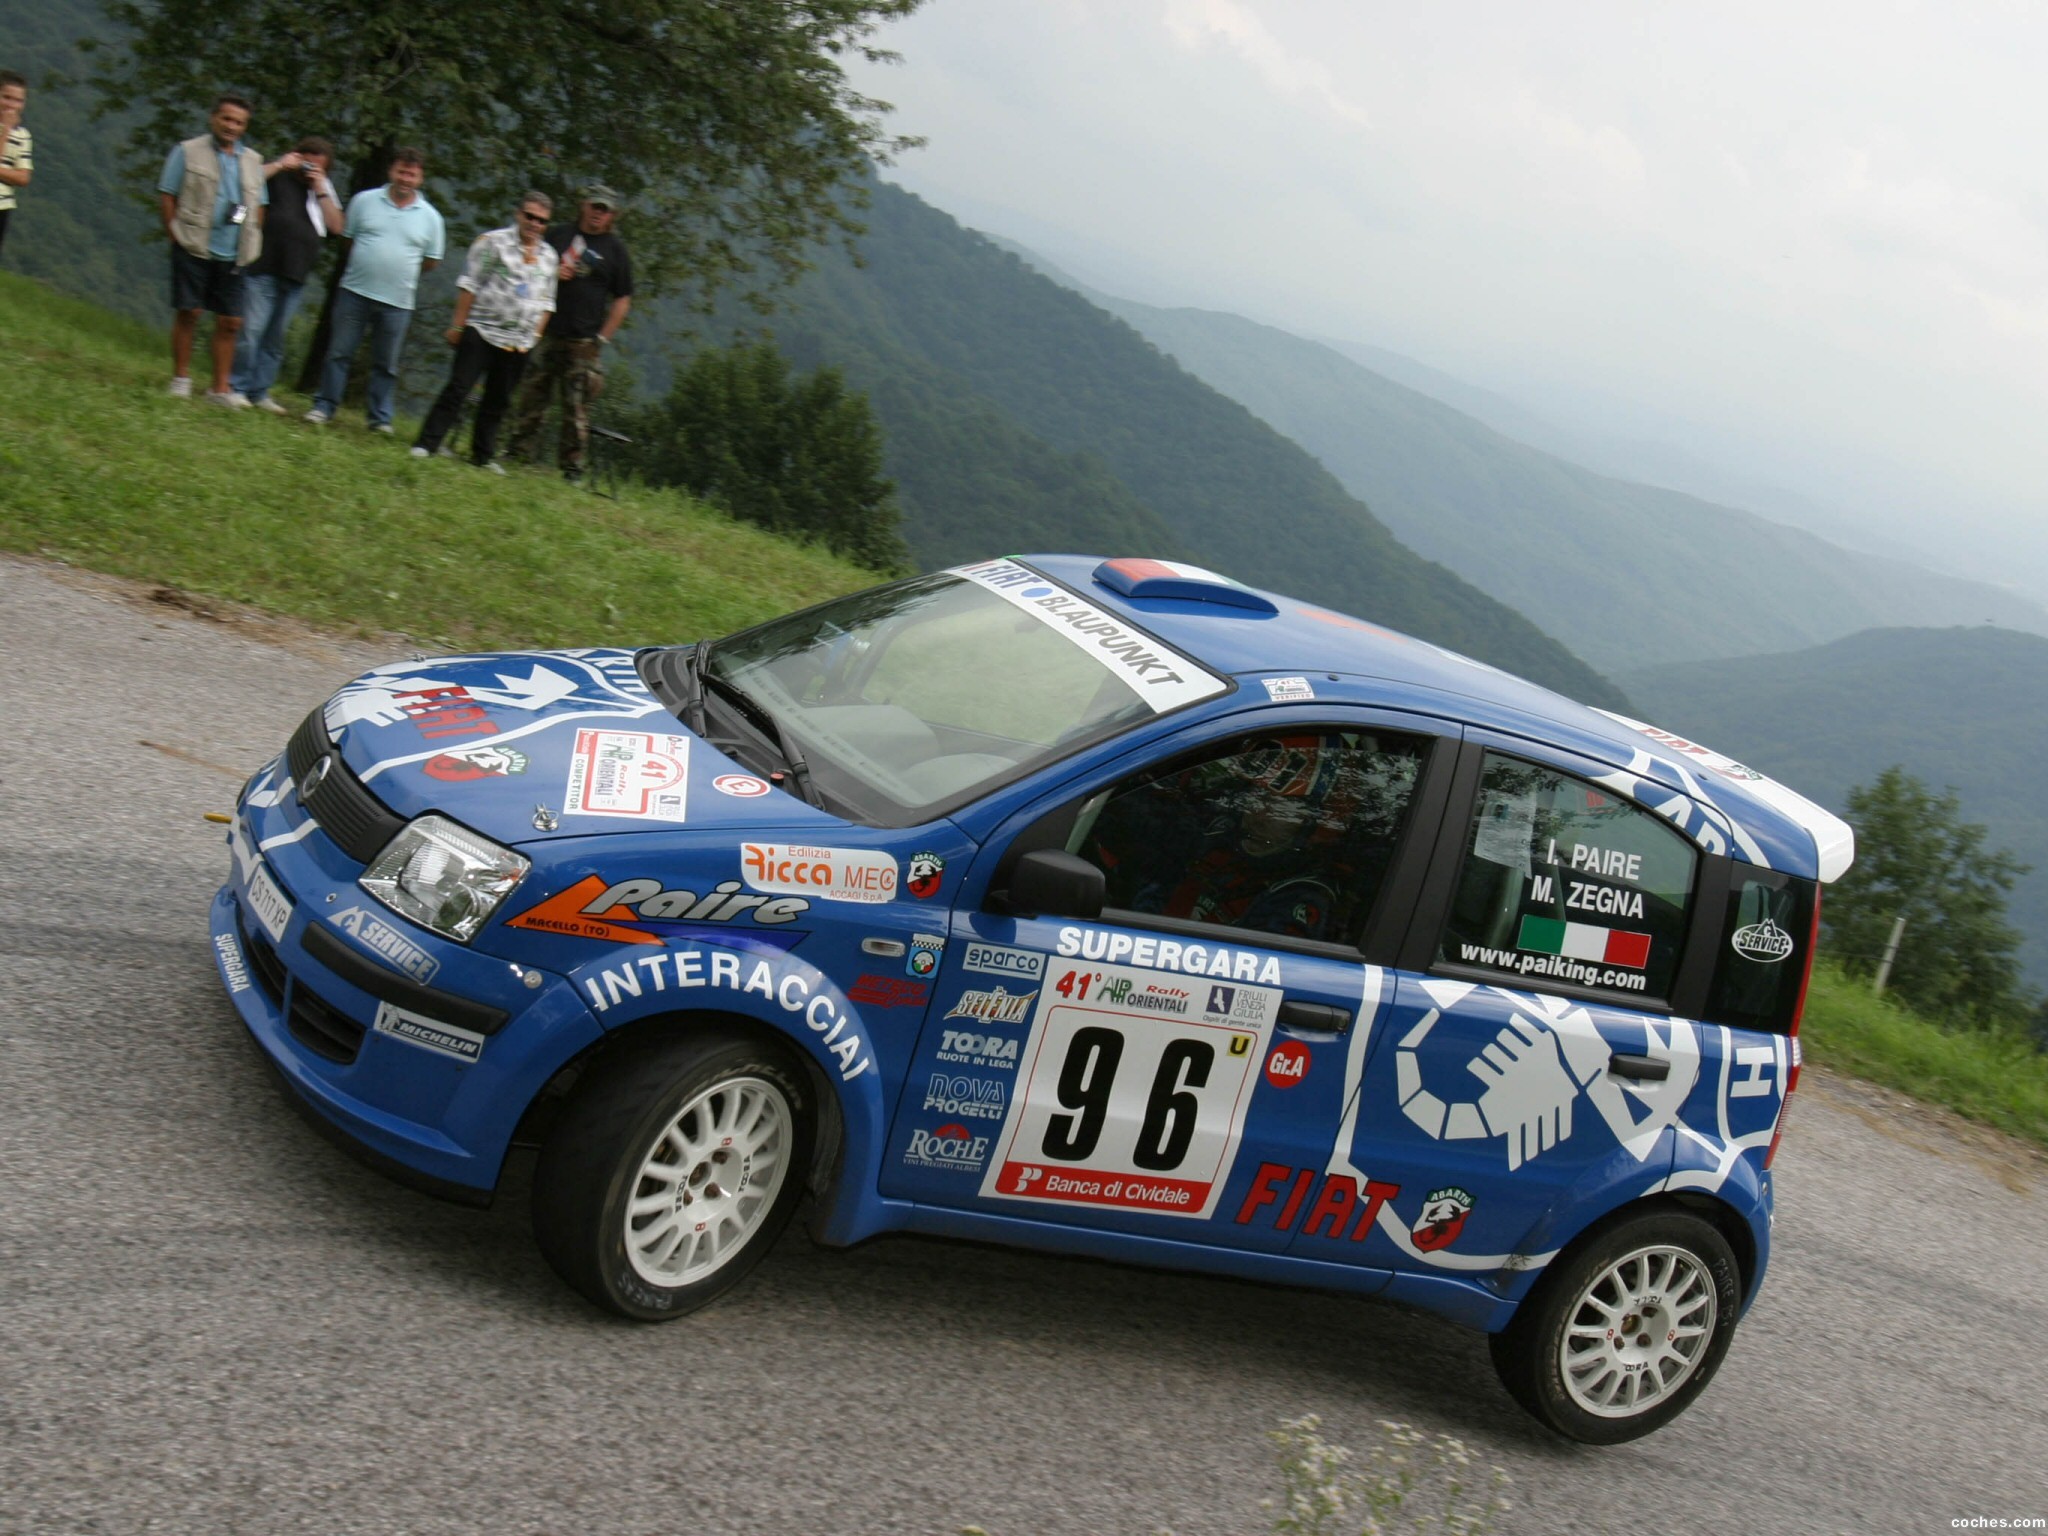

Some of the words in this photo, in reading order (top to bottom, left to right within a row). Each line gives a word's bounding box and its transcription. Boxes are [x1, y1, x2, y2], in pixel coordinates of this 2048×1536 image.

[1034, 596, 1185, 686] BLAUPUNKT
[389, 686, 500, 740] FIAT
[568, 758, 585, 810] COMPETITOR
[745, 844, 832, 886] Ricca
[788, 846, 832, 859] Edilizia
[1571, 843, 1642, 881] PAIRE
[579, 877, 810, 925] Paire
[1531, 874, 1555, 904] M.
[1566, 881, 1644, 919] ZEGNA
[526, 917, 580, 932] MACELLO
[583, 924, 610, 938] (TO)
[1739, 930, 1787, 954] SERVICE
[214, 933, 250, 993] SUPERGARA
[361, 921, 434, 980] SERVICE
[968, 948, 1039, 970] sparco
[1056, 926, 1282, 985] SUPERGARA
[1461, 943, 1647, 991] www.paiking.com
[1127, 993, 1188, 1014] ORIENTALI
[1146, 984, 1190, 999] Rally
[1238, 989, 1267, 1002] FRIULI
[585, 951, 870, 1082] INTERACCIAI
[1233, 1008, 1264, 1021] GIULIA
[399, 1021, 478, 1053] MICHELIN
[941, 1030, 1019, 1060] TOORA
[1229, 1037, 1250, 1054] U
[936, 1051, 970, 1063] RUOTE
[973, 1056, 986, 1066] IN
[988, 1058, 1014, 1070] LEGA
[1269, 1052, 1306, 1078] Gr.A
[923, 1096, 1004, 1120] PROGETTI
[906, 1129, 989, 1161] ROCHE
[1046, 1175, 1101, 1195] Banca
[1103, 1181, 1123, 1198] di
[1125, 1183, 1191, 1205] Cividale
[1234, 1161, 1401, 1242] FIAT
[1430, 1188, 1472, 1206] ABARTH
